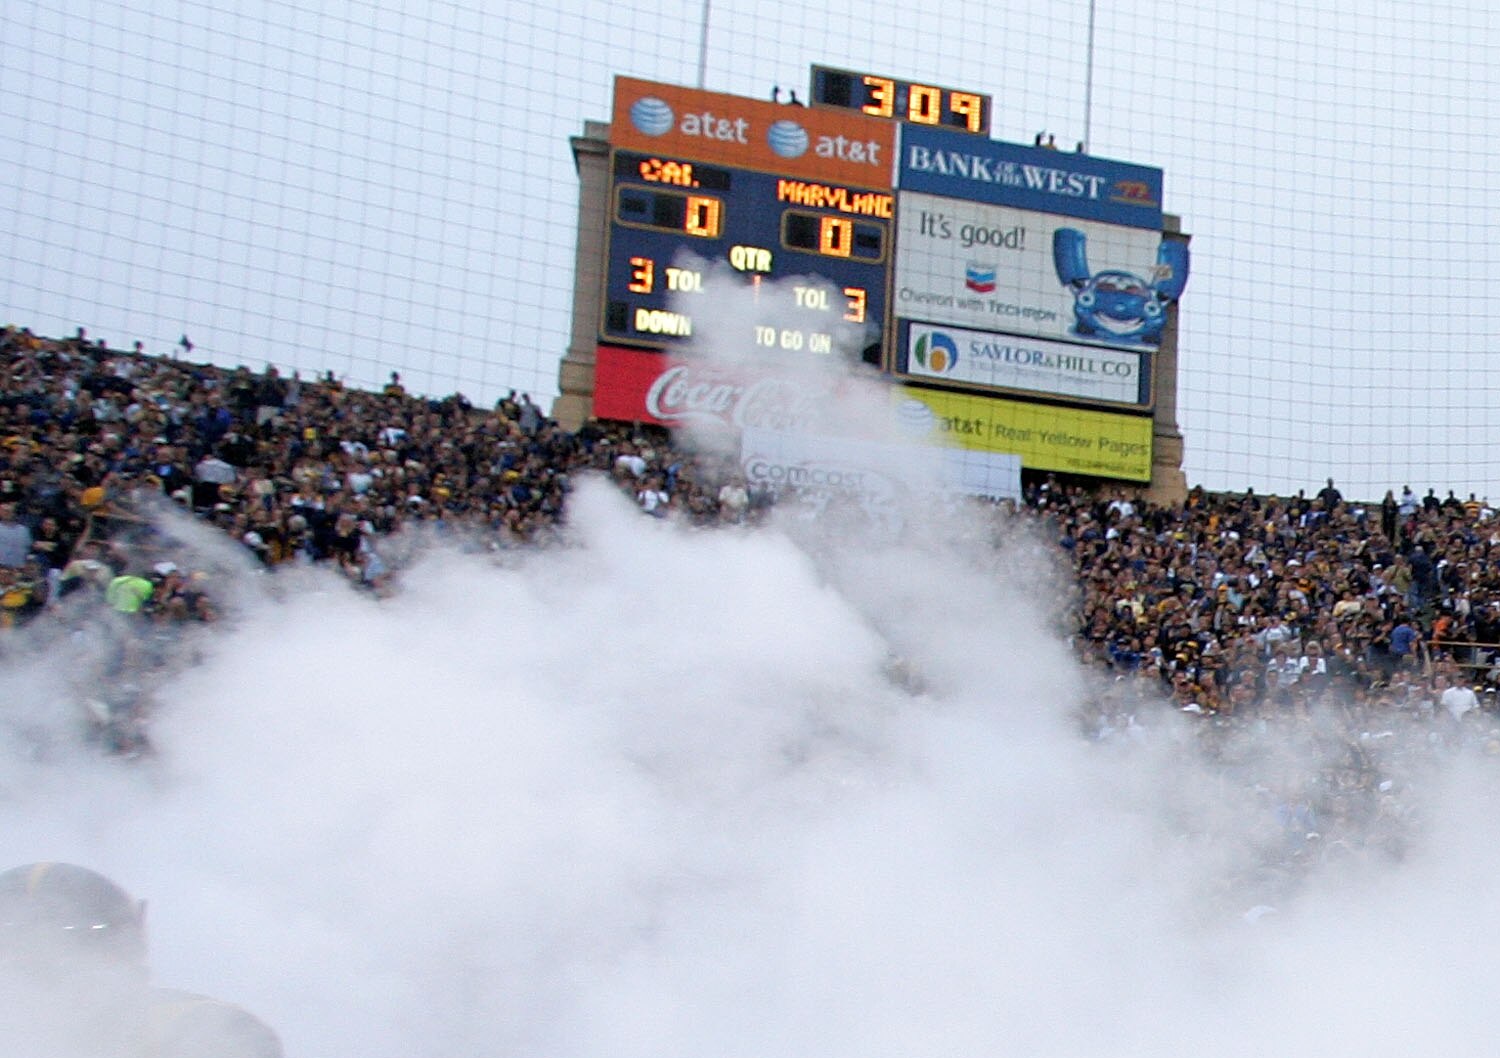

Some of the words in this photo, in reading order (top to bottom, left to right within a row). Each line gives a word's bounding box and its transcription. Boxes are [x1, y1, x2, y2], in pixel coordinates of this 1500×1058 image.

[680, 112, 749, 144] at&t
[815, 134, 881, 166] at&t
[909, 146, 992, 183] BANK
[1022, 164, 1105, 199] WEST
[685, 195, 720, 238] 0
[920, 211, 951, 238] It's
[960, 223, 1026, 253] good!
[819, 216, 852, 258] 0
[628, 257, 653, 294] 3
[665, 267, 704, 294] TOL
[729, 245, 772, 272] QTR
[635, 308, 691, 337] DOWN
[794, 286, 830, 311] TOL
[843, 288, 867, 323] 3
[756, 325, 775, 346] TO
[780, 329, 802, 350] GO
[810, 334, 831, 354] ON
[939, 416, 982, 436] at&t
[995, 424, 1031, 441] Real
[1038, 429, 1092, 448] Yellow
[1099, 436, 1149, 457] Pages
